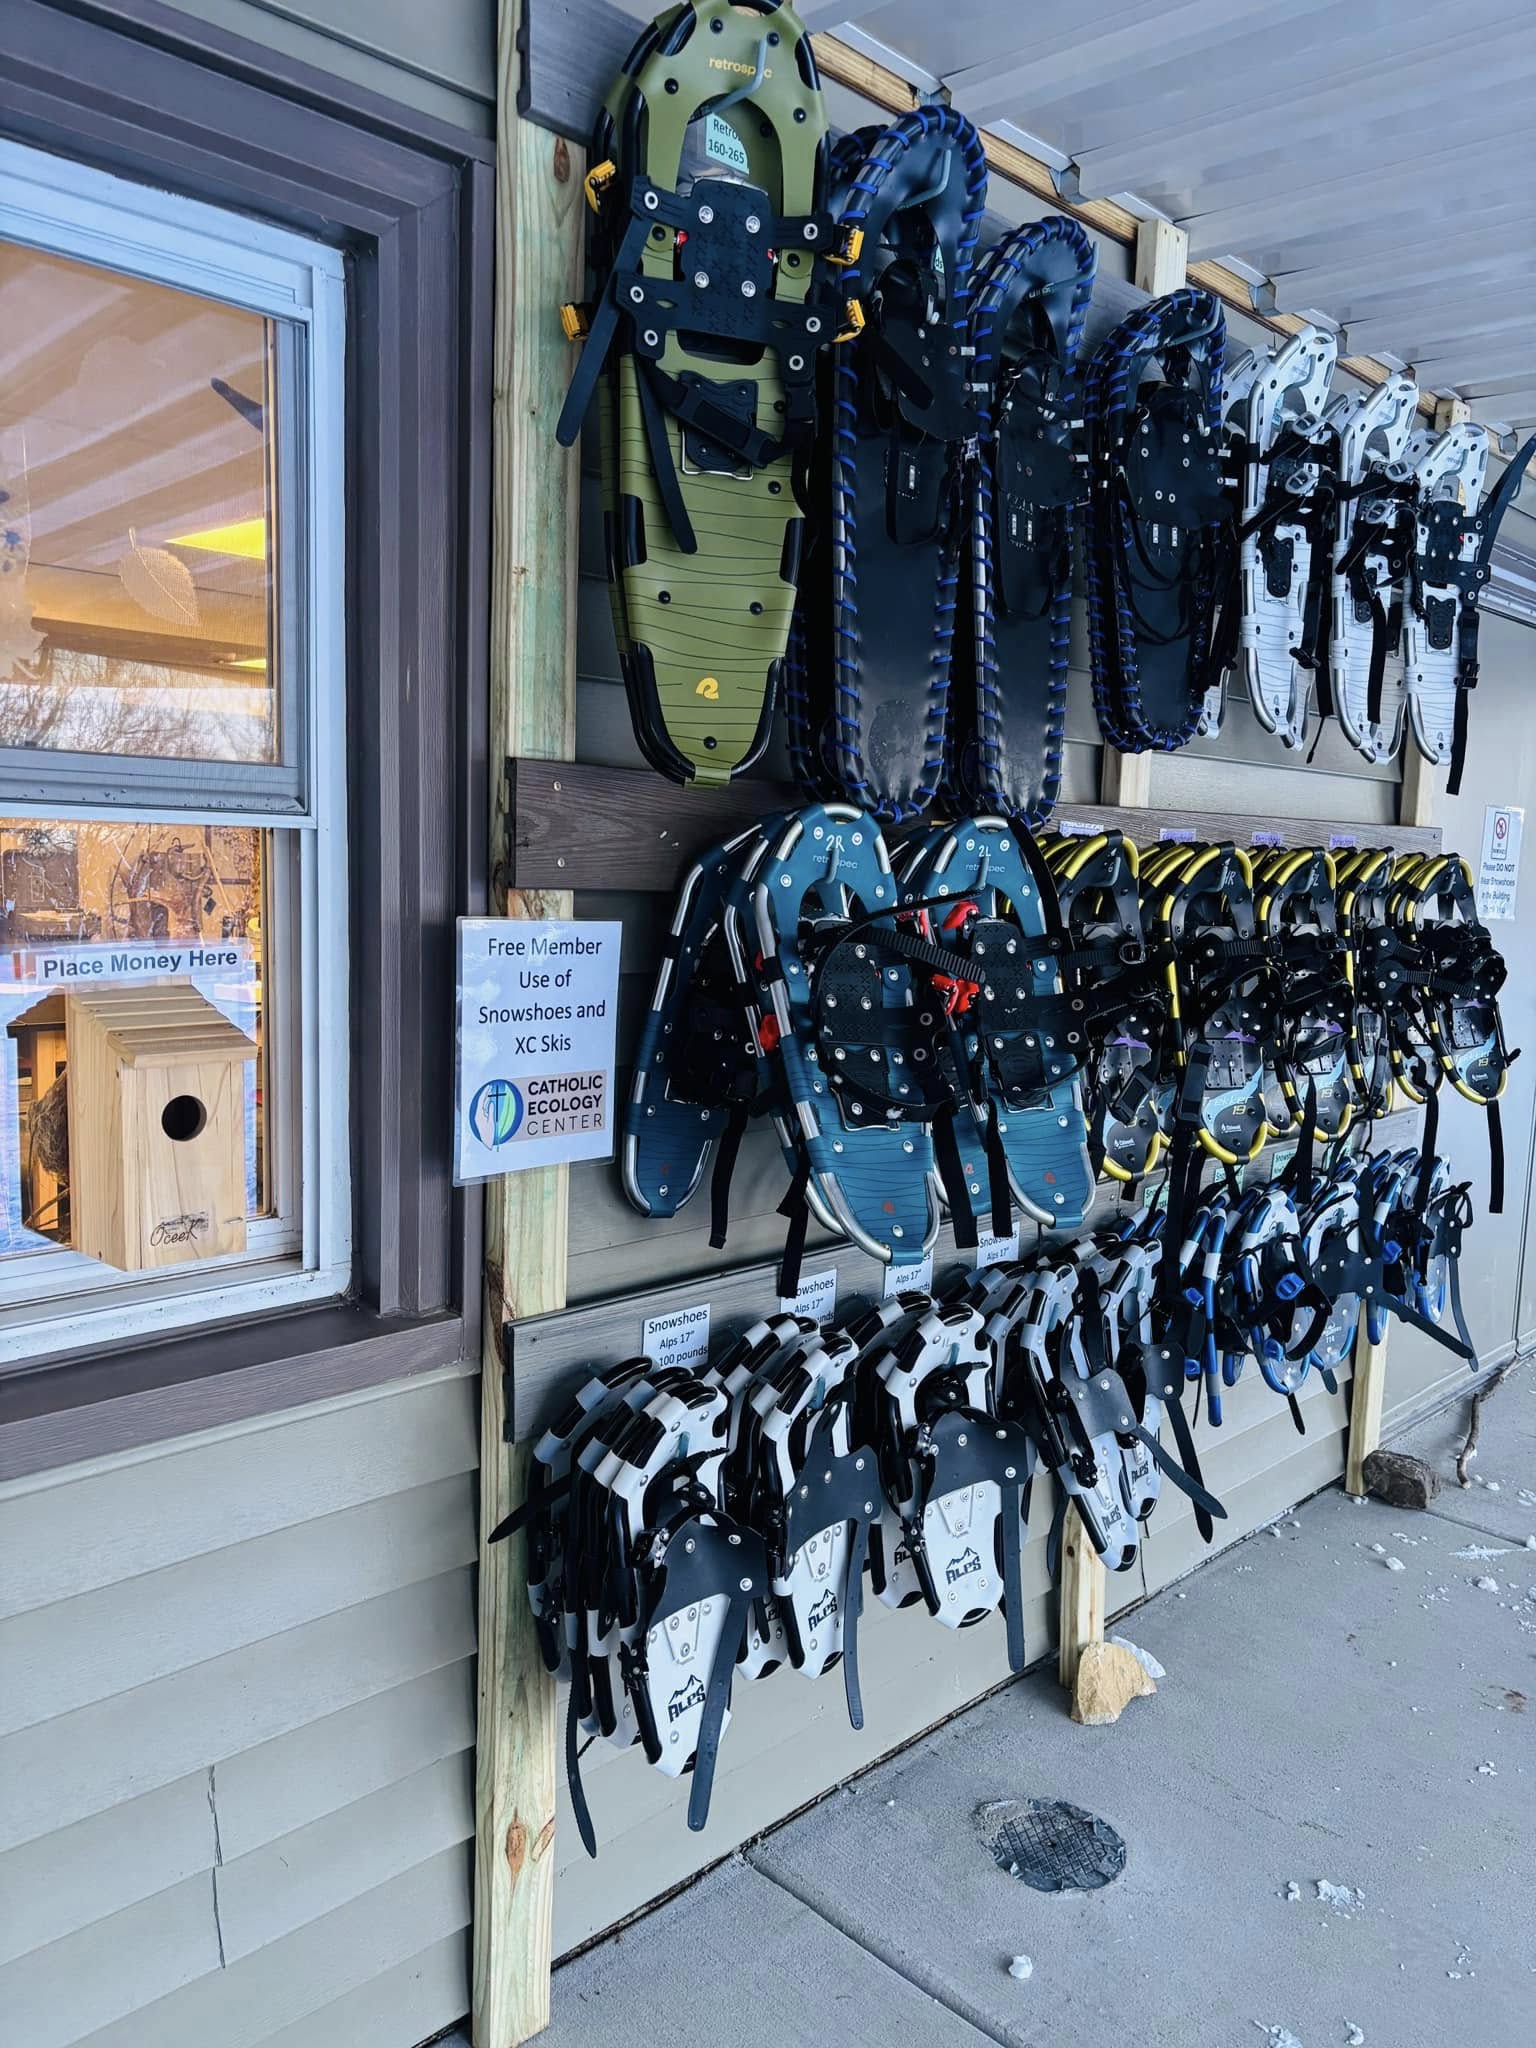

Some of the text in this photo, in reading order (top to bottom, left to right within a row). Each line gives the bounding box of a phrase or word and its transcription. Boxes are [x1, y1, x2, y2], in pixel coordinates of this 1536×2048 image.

[708, 57, 773, 79] retrospc
[713, 119, 741, 140] Retro
[708, 139, 745, 164] 160-265
[826, 834, 845, 852] 2R
[978, 844, 992, 857] 2L
[812, 855, 858, 869] retrpec
[965, 863, 1006, 873] retrpec
[488, 936, 603, 957] Free Member
[43, 950, 239, 978] Place Money Here
[519, 969, 573, 989] Use of
[478, 1000, 606, 1024] Snowshoes and
[515, 1033, 572, 1055] XC Skis
[527, 1074, 603, 1096] CATHOLIC
[527, 1094, 603, 1116] ECOLOGY
[526, 1113, 603, 1136] CENTER
[797, 1278, 835, 1297] owshoes
[794, 1297, 824, 1313] Alps 17"
[648, 1310, 708, 1335] Snowshoes
[659, 1330, 696, 1350] Alps 17"
[676, 1344, 708, 1365] pounds
[945, 1555, 982, 1585] ALPS
[808, 1597, 838, 1632] ALPS
[668, 1685, 706, 1723] ALPS
